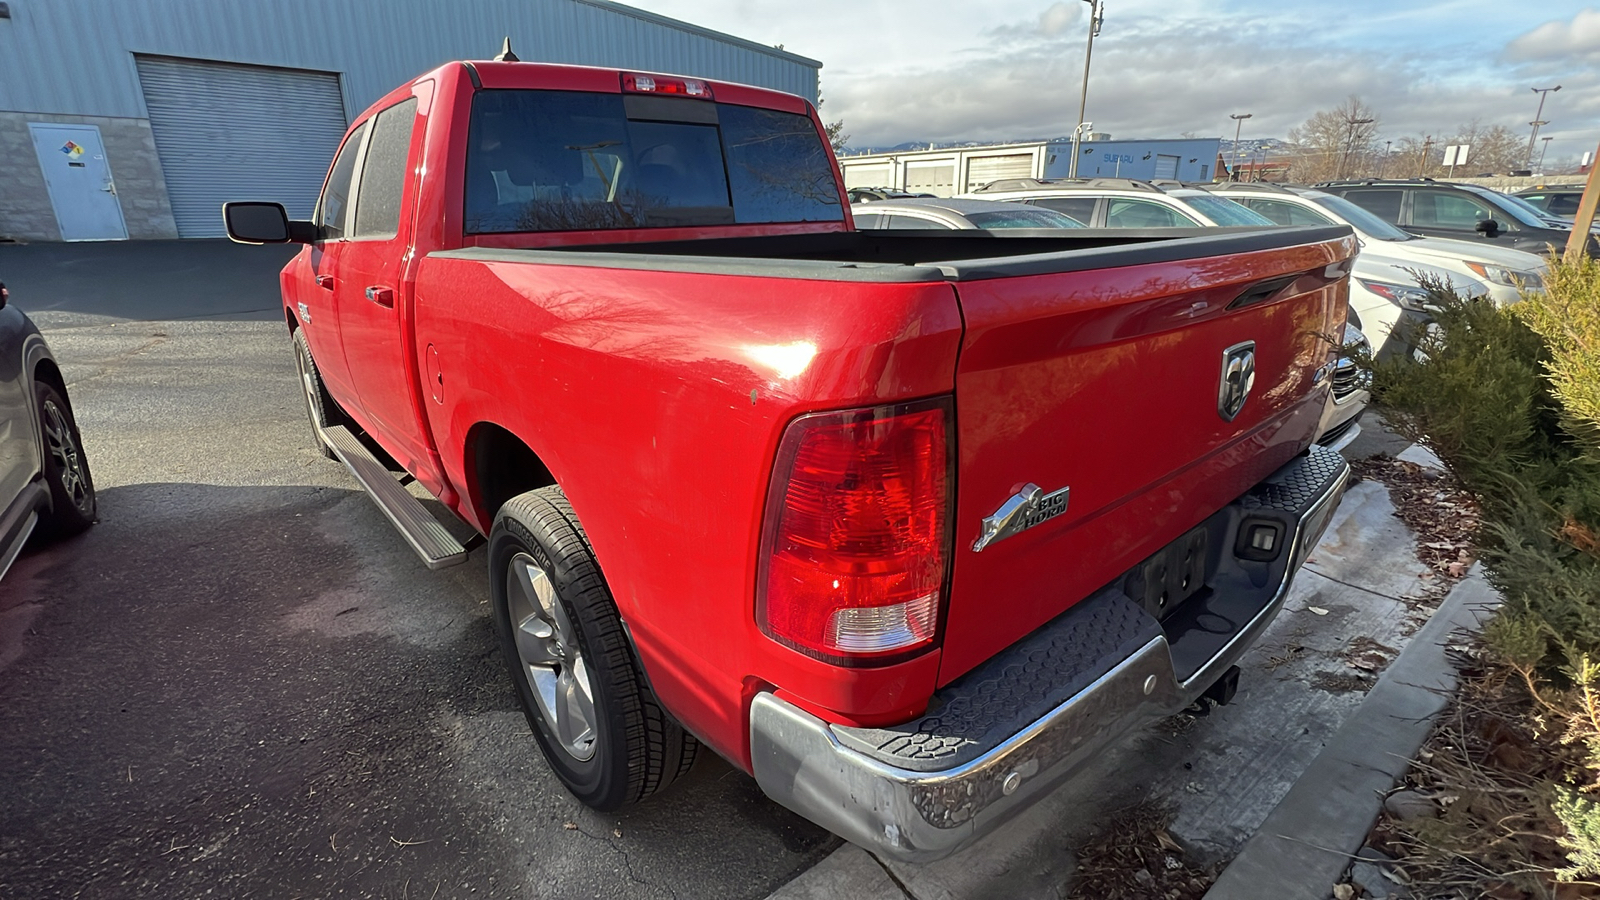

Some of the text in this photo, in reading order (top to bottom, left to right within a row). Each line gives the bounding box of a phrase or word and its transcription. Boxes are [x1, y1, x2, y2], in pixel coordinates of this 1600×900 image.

[1104, 153, 1134, 164] SUBARU
[1038, 493, 1063, 511] BIG
[1024, 503, 1066, 528] HORN
[507, 518, 551, 569] BRIDGESTONE
